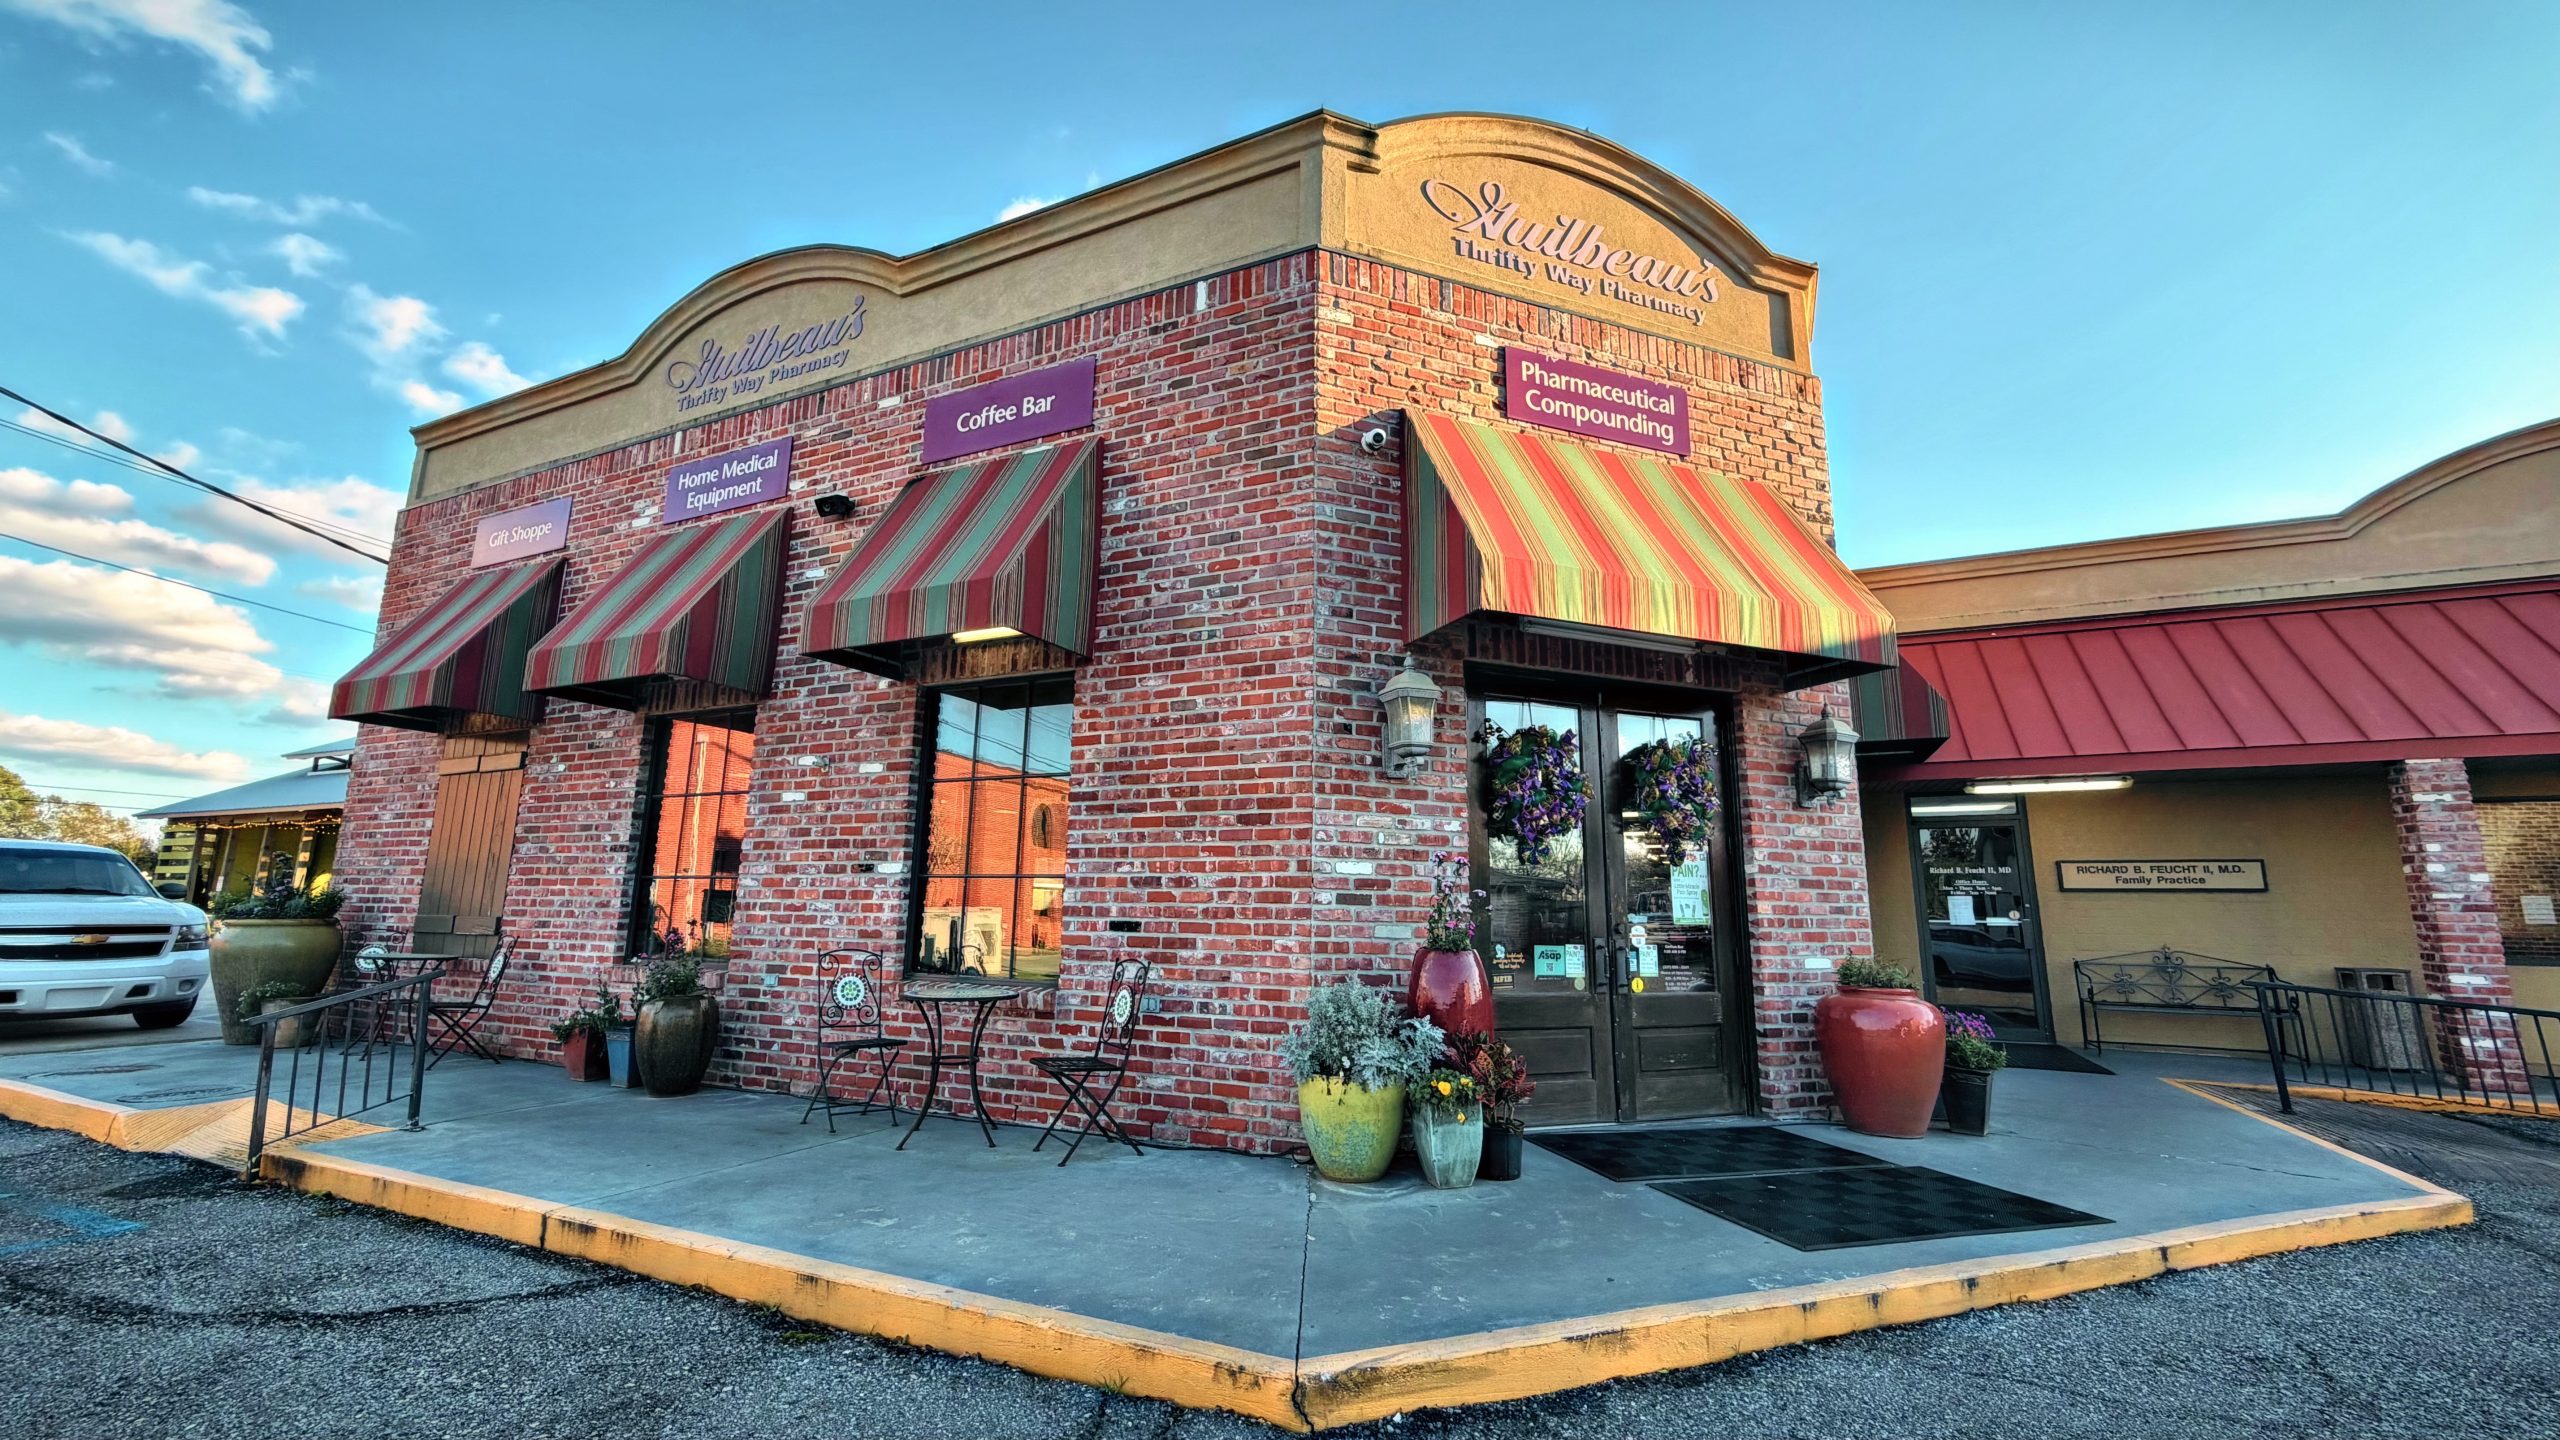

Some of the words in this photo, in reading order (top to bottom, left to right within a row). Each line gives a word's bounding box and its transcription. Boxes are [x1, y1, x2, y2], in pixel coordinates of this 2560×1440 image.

[1420, 178, 1720, 303] Guilbeau's
[1451, 236, 1536, 280] Thrifty
[1545, 262, 1595, 296] Way
[1600, 278, 1706, 326] Pharmacy
[667, 294, 867, 394] Guilbeau's
[678, 386, 727, 412] Thrifty
[732, 375, 764, 396] Way
[768, 349, 850, 384] Pharmacy
[1521, 361, 1675, 416] Pharmaceutical
[956, 404, 1018, 433] Coffee
[1022, 394, 1056, 418] Bar
[1525, 389, 1674, 446] Compounding
[678, 468, 719, 491] Home
[722, 449, 778, 480] Medical
[686, 476, 763, 512] Equipment
[489, 529, 509, 547] Gift
[510, 522, 552, 543] Shoppe
[1671, 863, 1700, 878] PAIN?
[1929, 866, 1954, 874] Richard
[1965, 866, 1986, 874] Feucht
[1998, 866, 2012, 874] MD
[2076, 865, 2129, 874] RICHARD
[2133, 865, 2145, 874] B.
[2150, 865, 2198, 874] FEUCHT
[2203, 865, 2214, 875] II,
[2218, 864, 2246, 874] M.D.
[2115, 876, 2151, 885] Family
[2157, 876, 2206, 885] Practice
[1538, 950, 1562, 962] Asap
